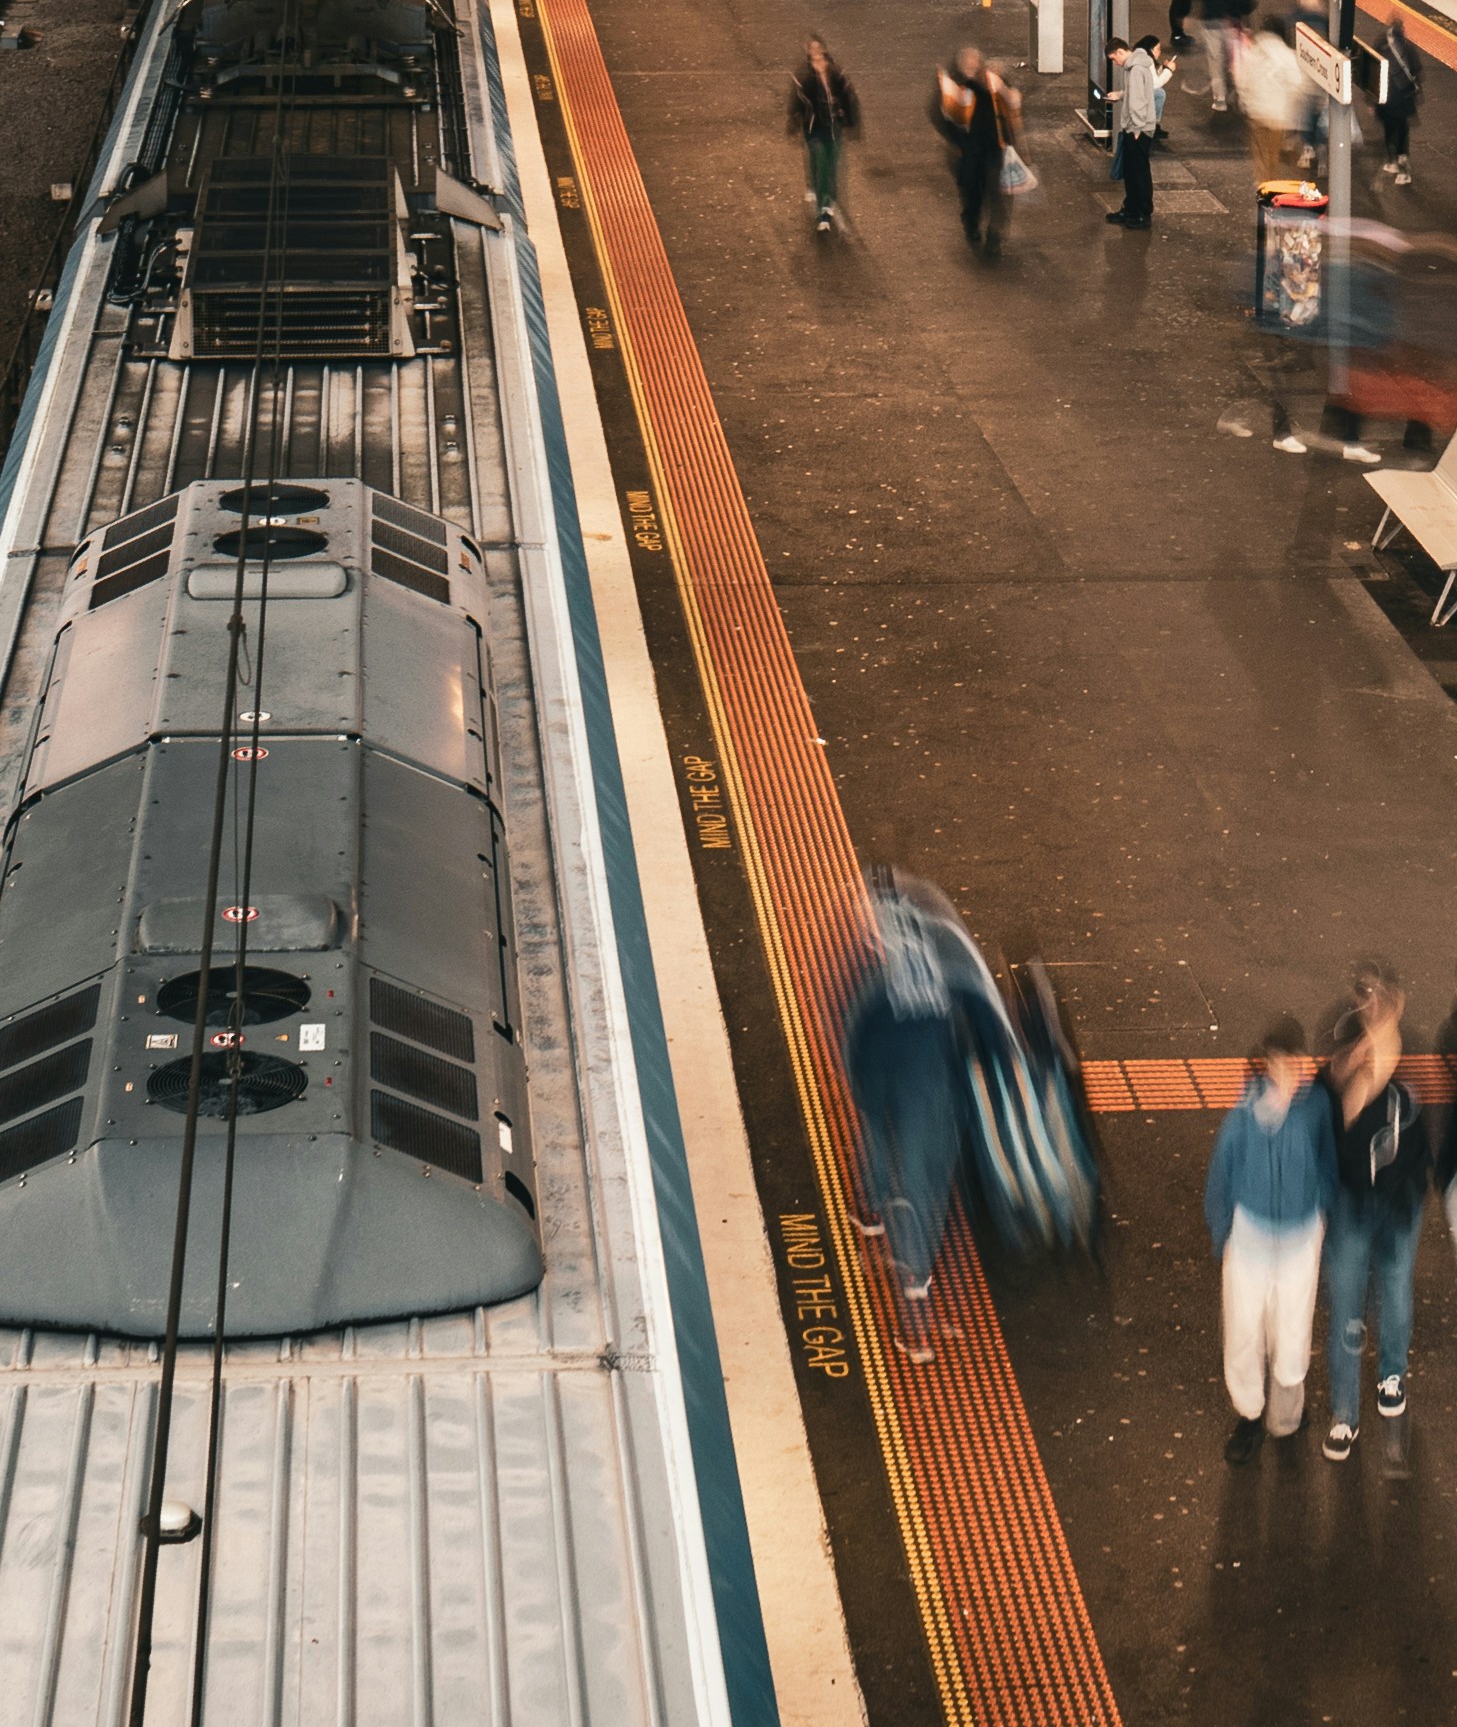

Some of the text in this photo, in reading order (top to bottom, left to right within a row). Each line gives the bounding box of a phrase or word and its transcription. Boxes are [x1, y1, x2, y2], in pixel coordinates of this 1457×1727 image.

[1335, 62, 1340, 93] 9
[631, 513, 658, 531] THE
[635, 532, 663, 551] GAP
[683, 755, 732, 849] MIND THE GAP
[779, 1213, 849, 1378] MIND THE GAP
